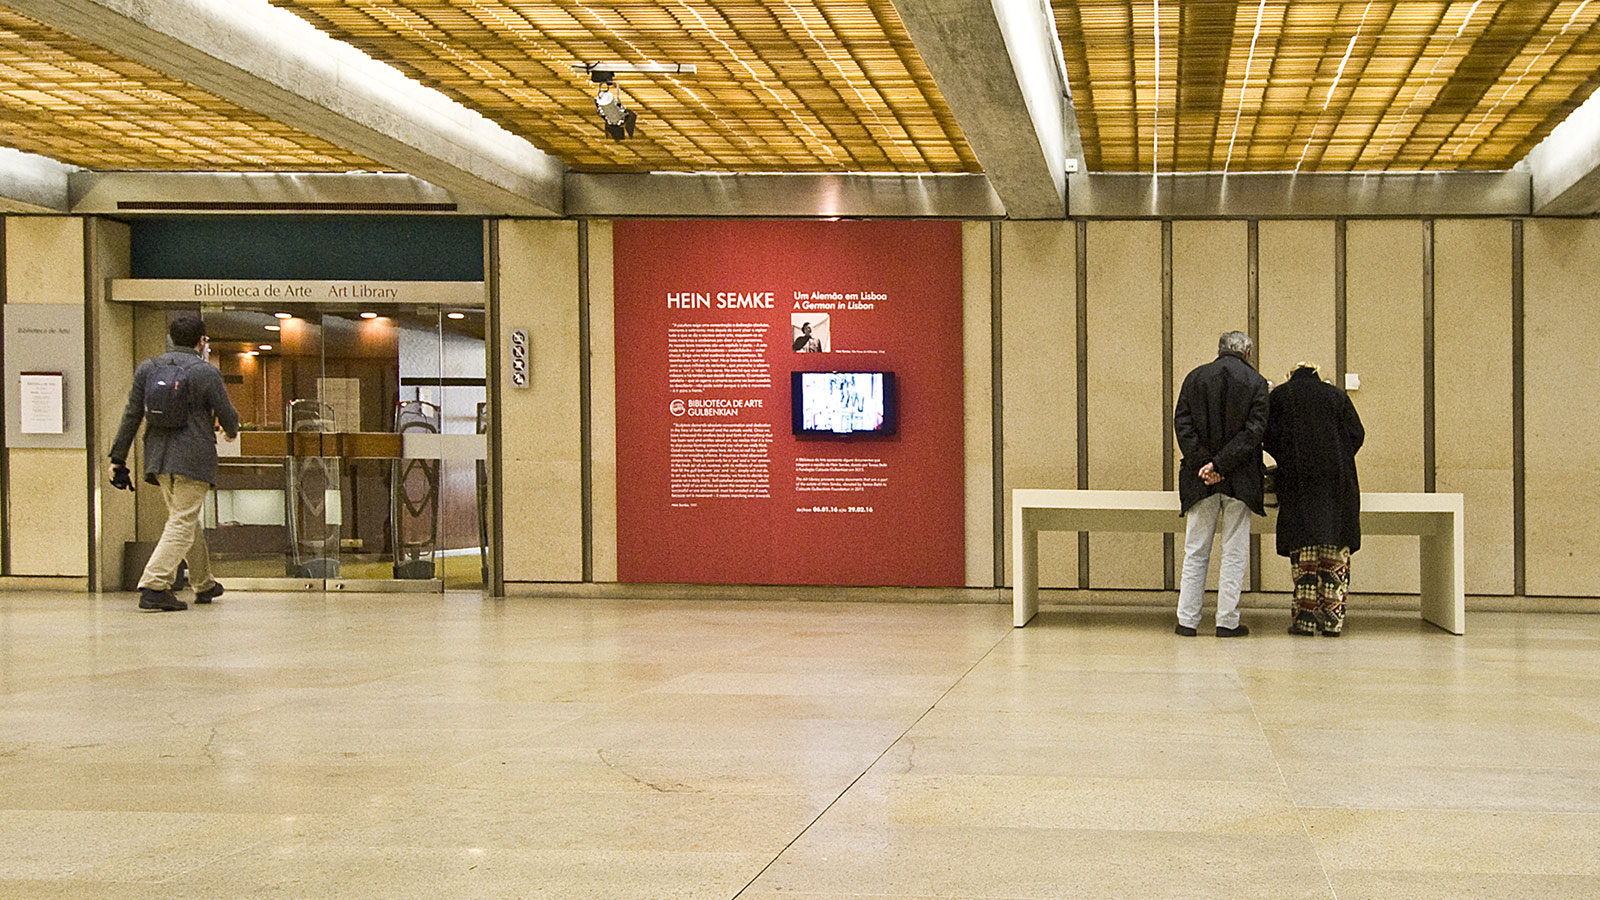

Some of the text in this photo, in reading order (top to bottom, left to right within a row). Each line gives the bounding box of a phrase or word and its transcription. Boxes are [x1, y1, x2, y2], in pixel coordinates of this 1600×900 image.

[194, 284, 398, 300] Biblioteca de Arte Art Library
[793, 291, 809, 300] Um
[810, 290, 843, 300] Alemão
[860, 291, 887, 301] Lisboa
[667, 292, 774, 309] HEIN SEMKE
[793, 301, 874, 310] A German in Lisbon
[688, 399, 763, 408] BIBLIOTECA DE ARTE
[688, 408, 738, 416] GULBENKIAN
